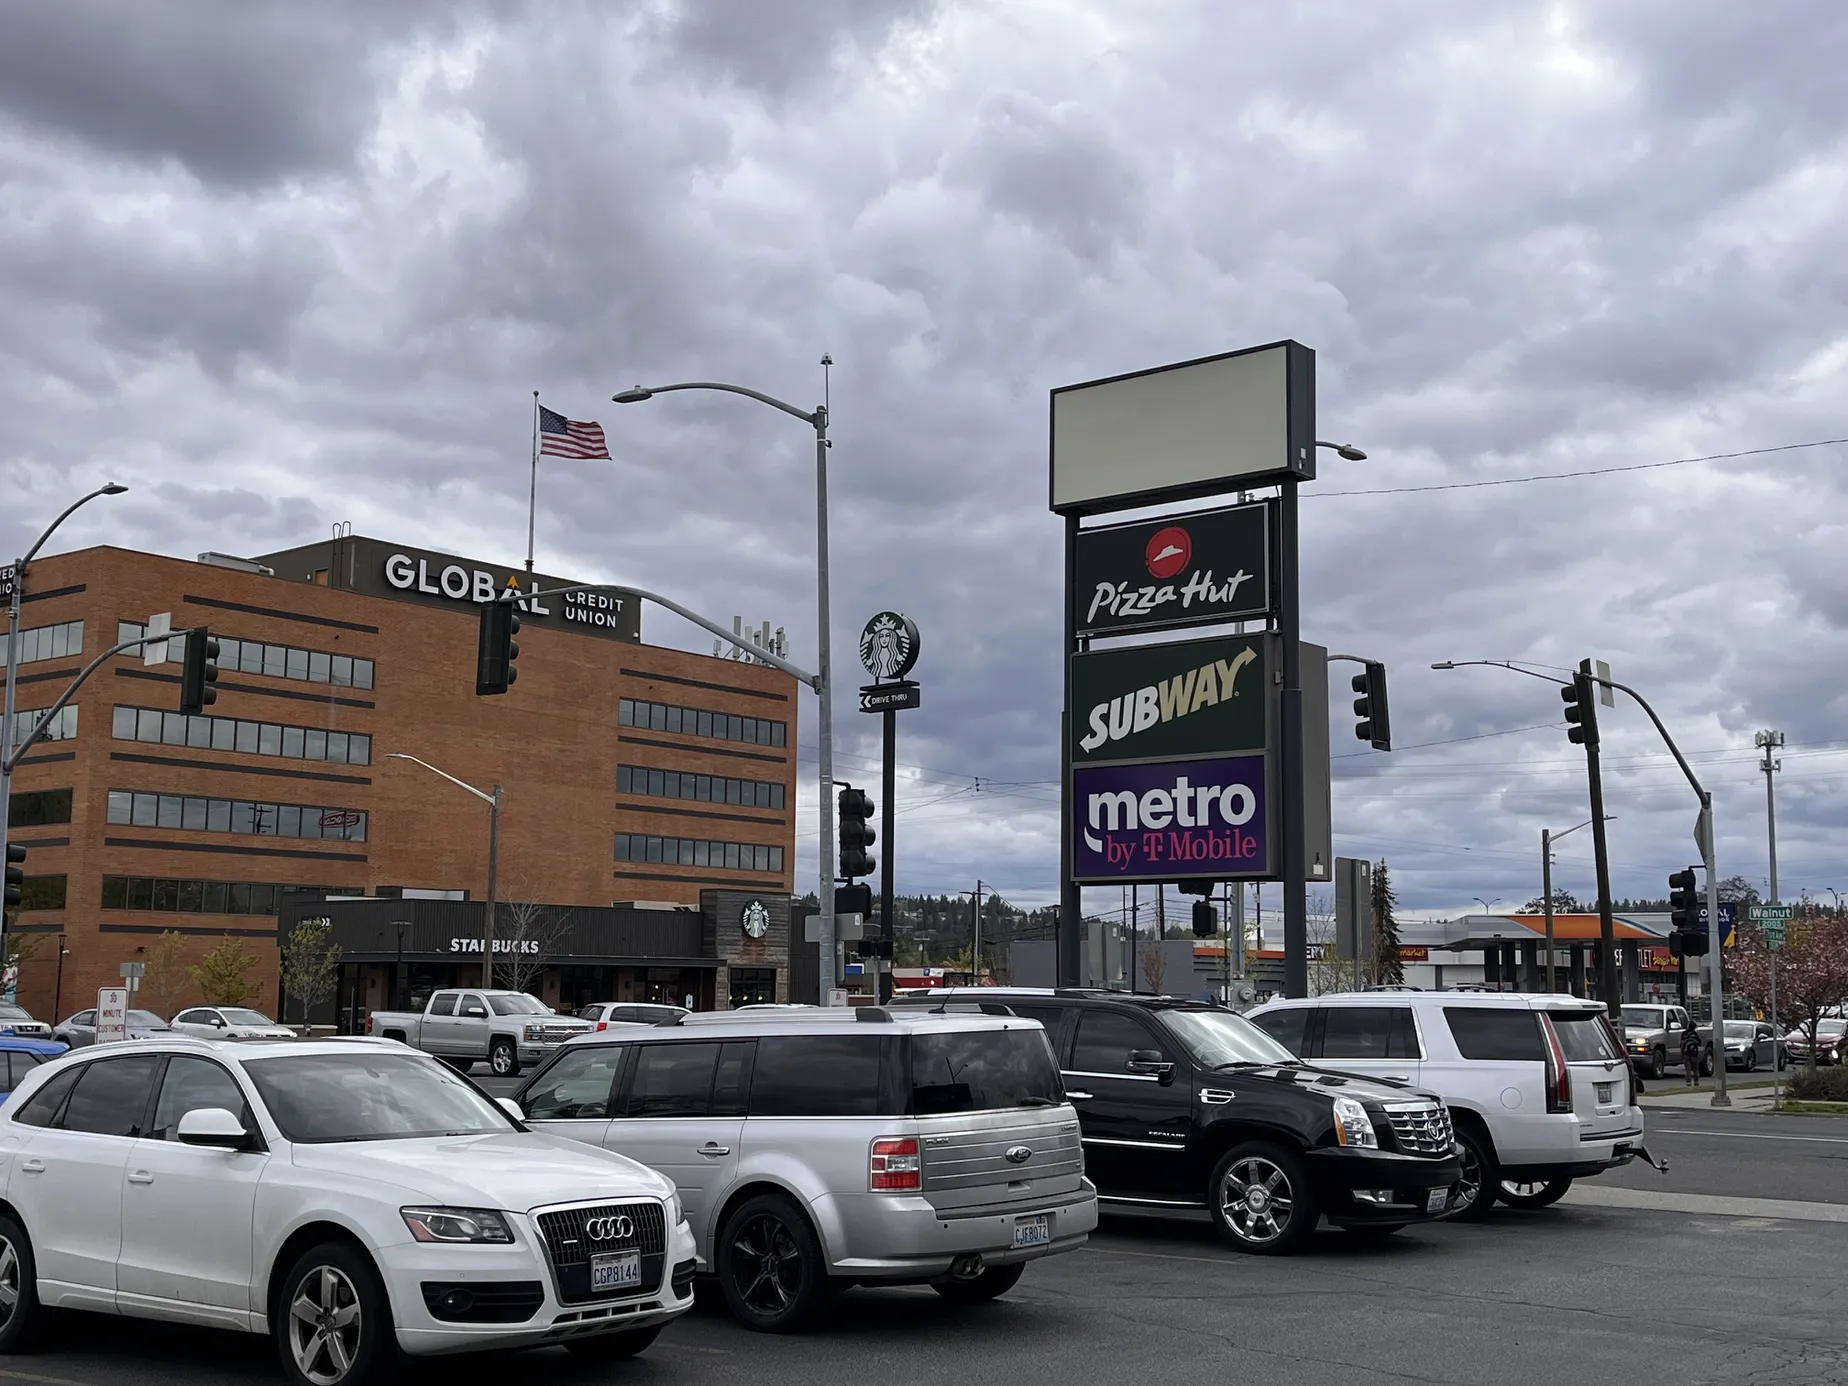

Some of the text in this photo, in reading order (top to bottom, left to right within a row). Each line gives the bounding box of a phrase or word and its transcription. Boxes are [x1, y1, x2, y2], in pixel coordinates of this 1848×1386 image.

[385, 553, 550, 616] GLOBAL
[565, 591, 624, 612] CREDIT
[1087, 568, 1254, 624] Pizza Hut
[565, 606, 617, 628] UNION
[871, 693, 908, 705] DRIVE THRU
[1079, 645, 1258, 754] SUBWAY
[1087, 776, 1257, 832] metro
[1106, 834, 1136, 871] by
[1168, 828, 1257, 861] Mobile
[1752, 908, 1792, 918] Walnut
[450, 938, 539, 954] STABUCKS
[103, 1009, 122, 1017] MINUTE
[98, 1024, 124, 1033] CUSTOMER
[1015, 1225, 1048, 1243] CJF8072
[594, 1263, 638, 1284] CGP8144
